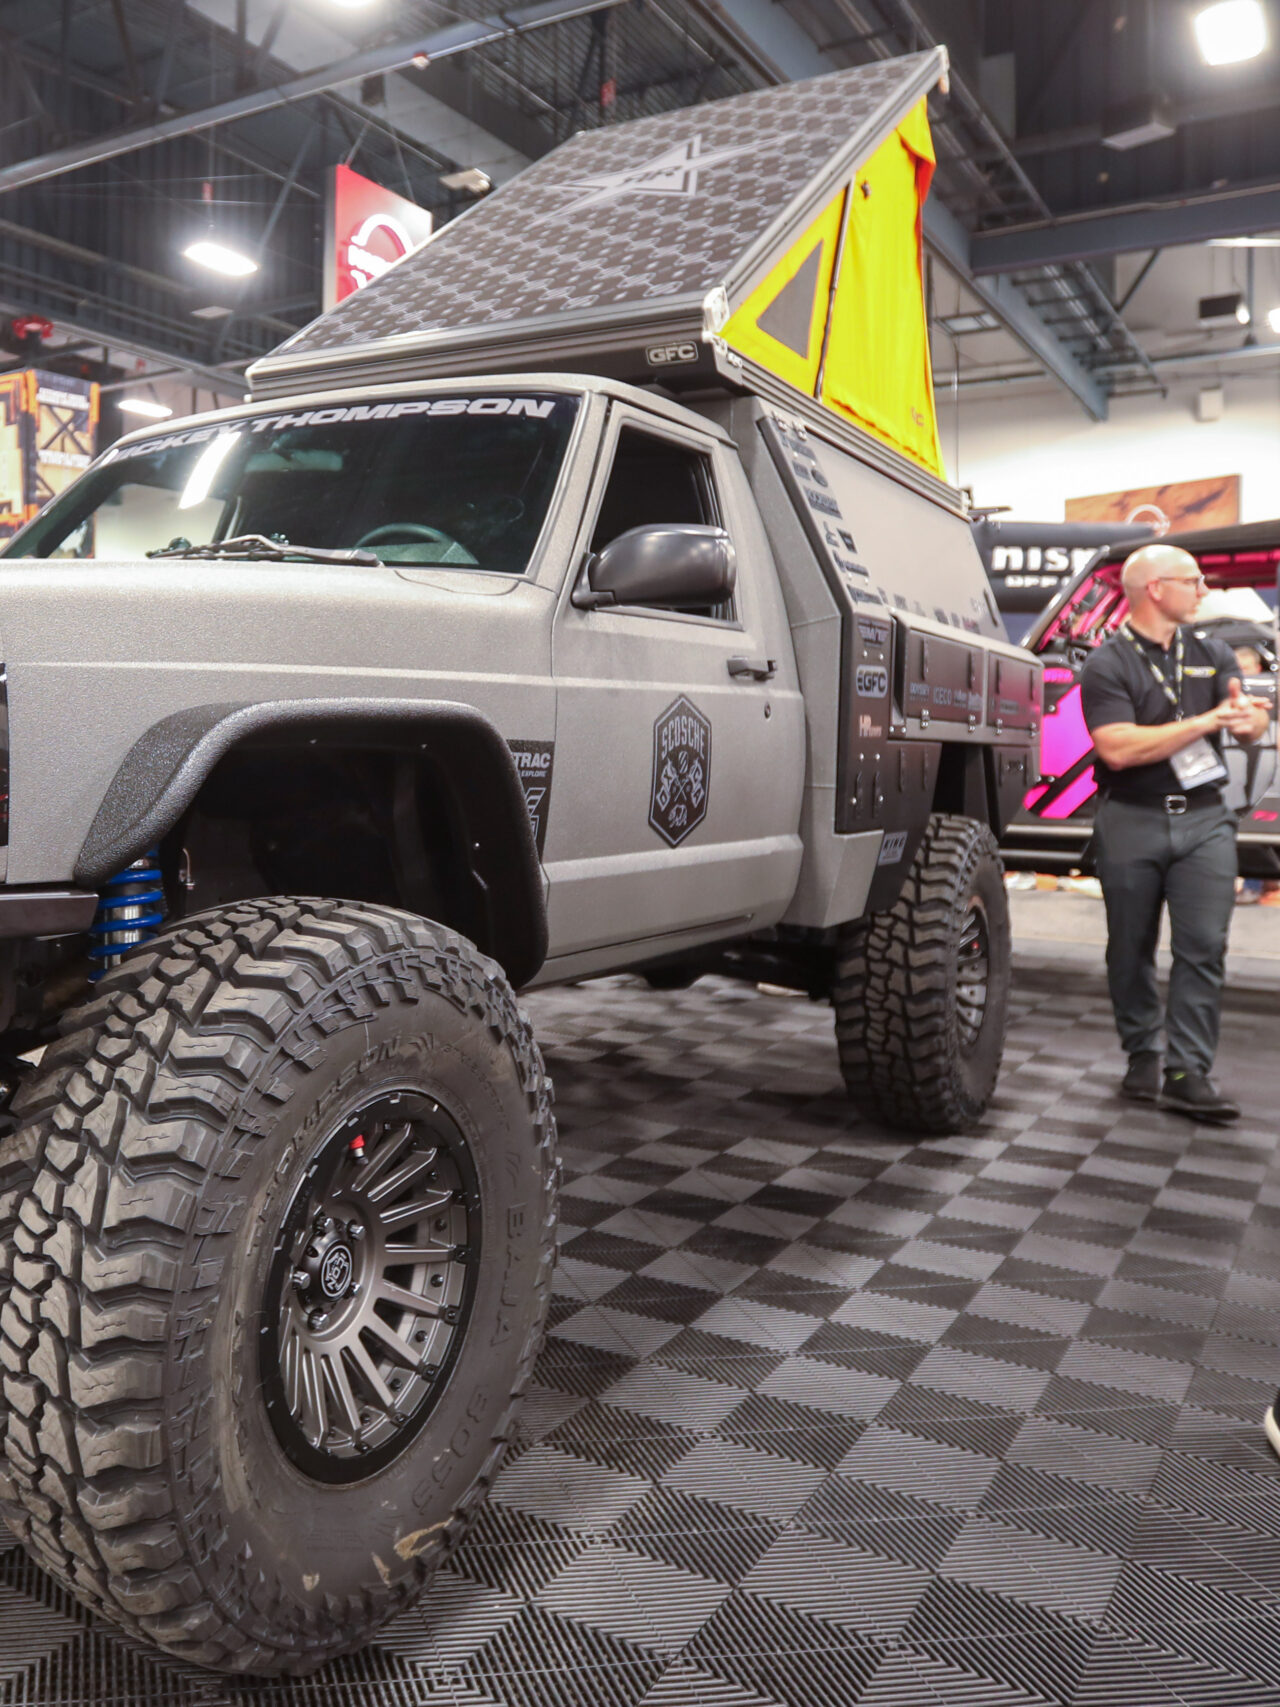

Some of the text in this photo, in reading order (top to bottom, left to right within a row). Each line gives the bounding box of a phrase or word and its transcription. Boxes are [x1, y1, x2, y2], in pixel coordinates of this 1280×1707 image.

[648, 343, 696, 363] GFC
[249, 398, 556, 433] THOMPSON
[661, 715, 706, 761] SCOSCHE
[511, 752, 551, 769] TRAC
